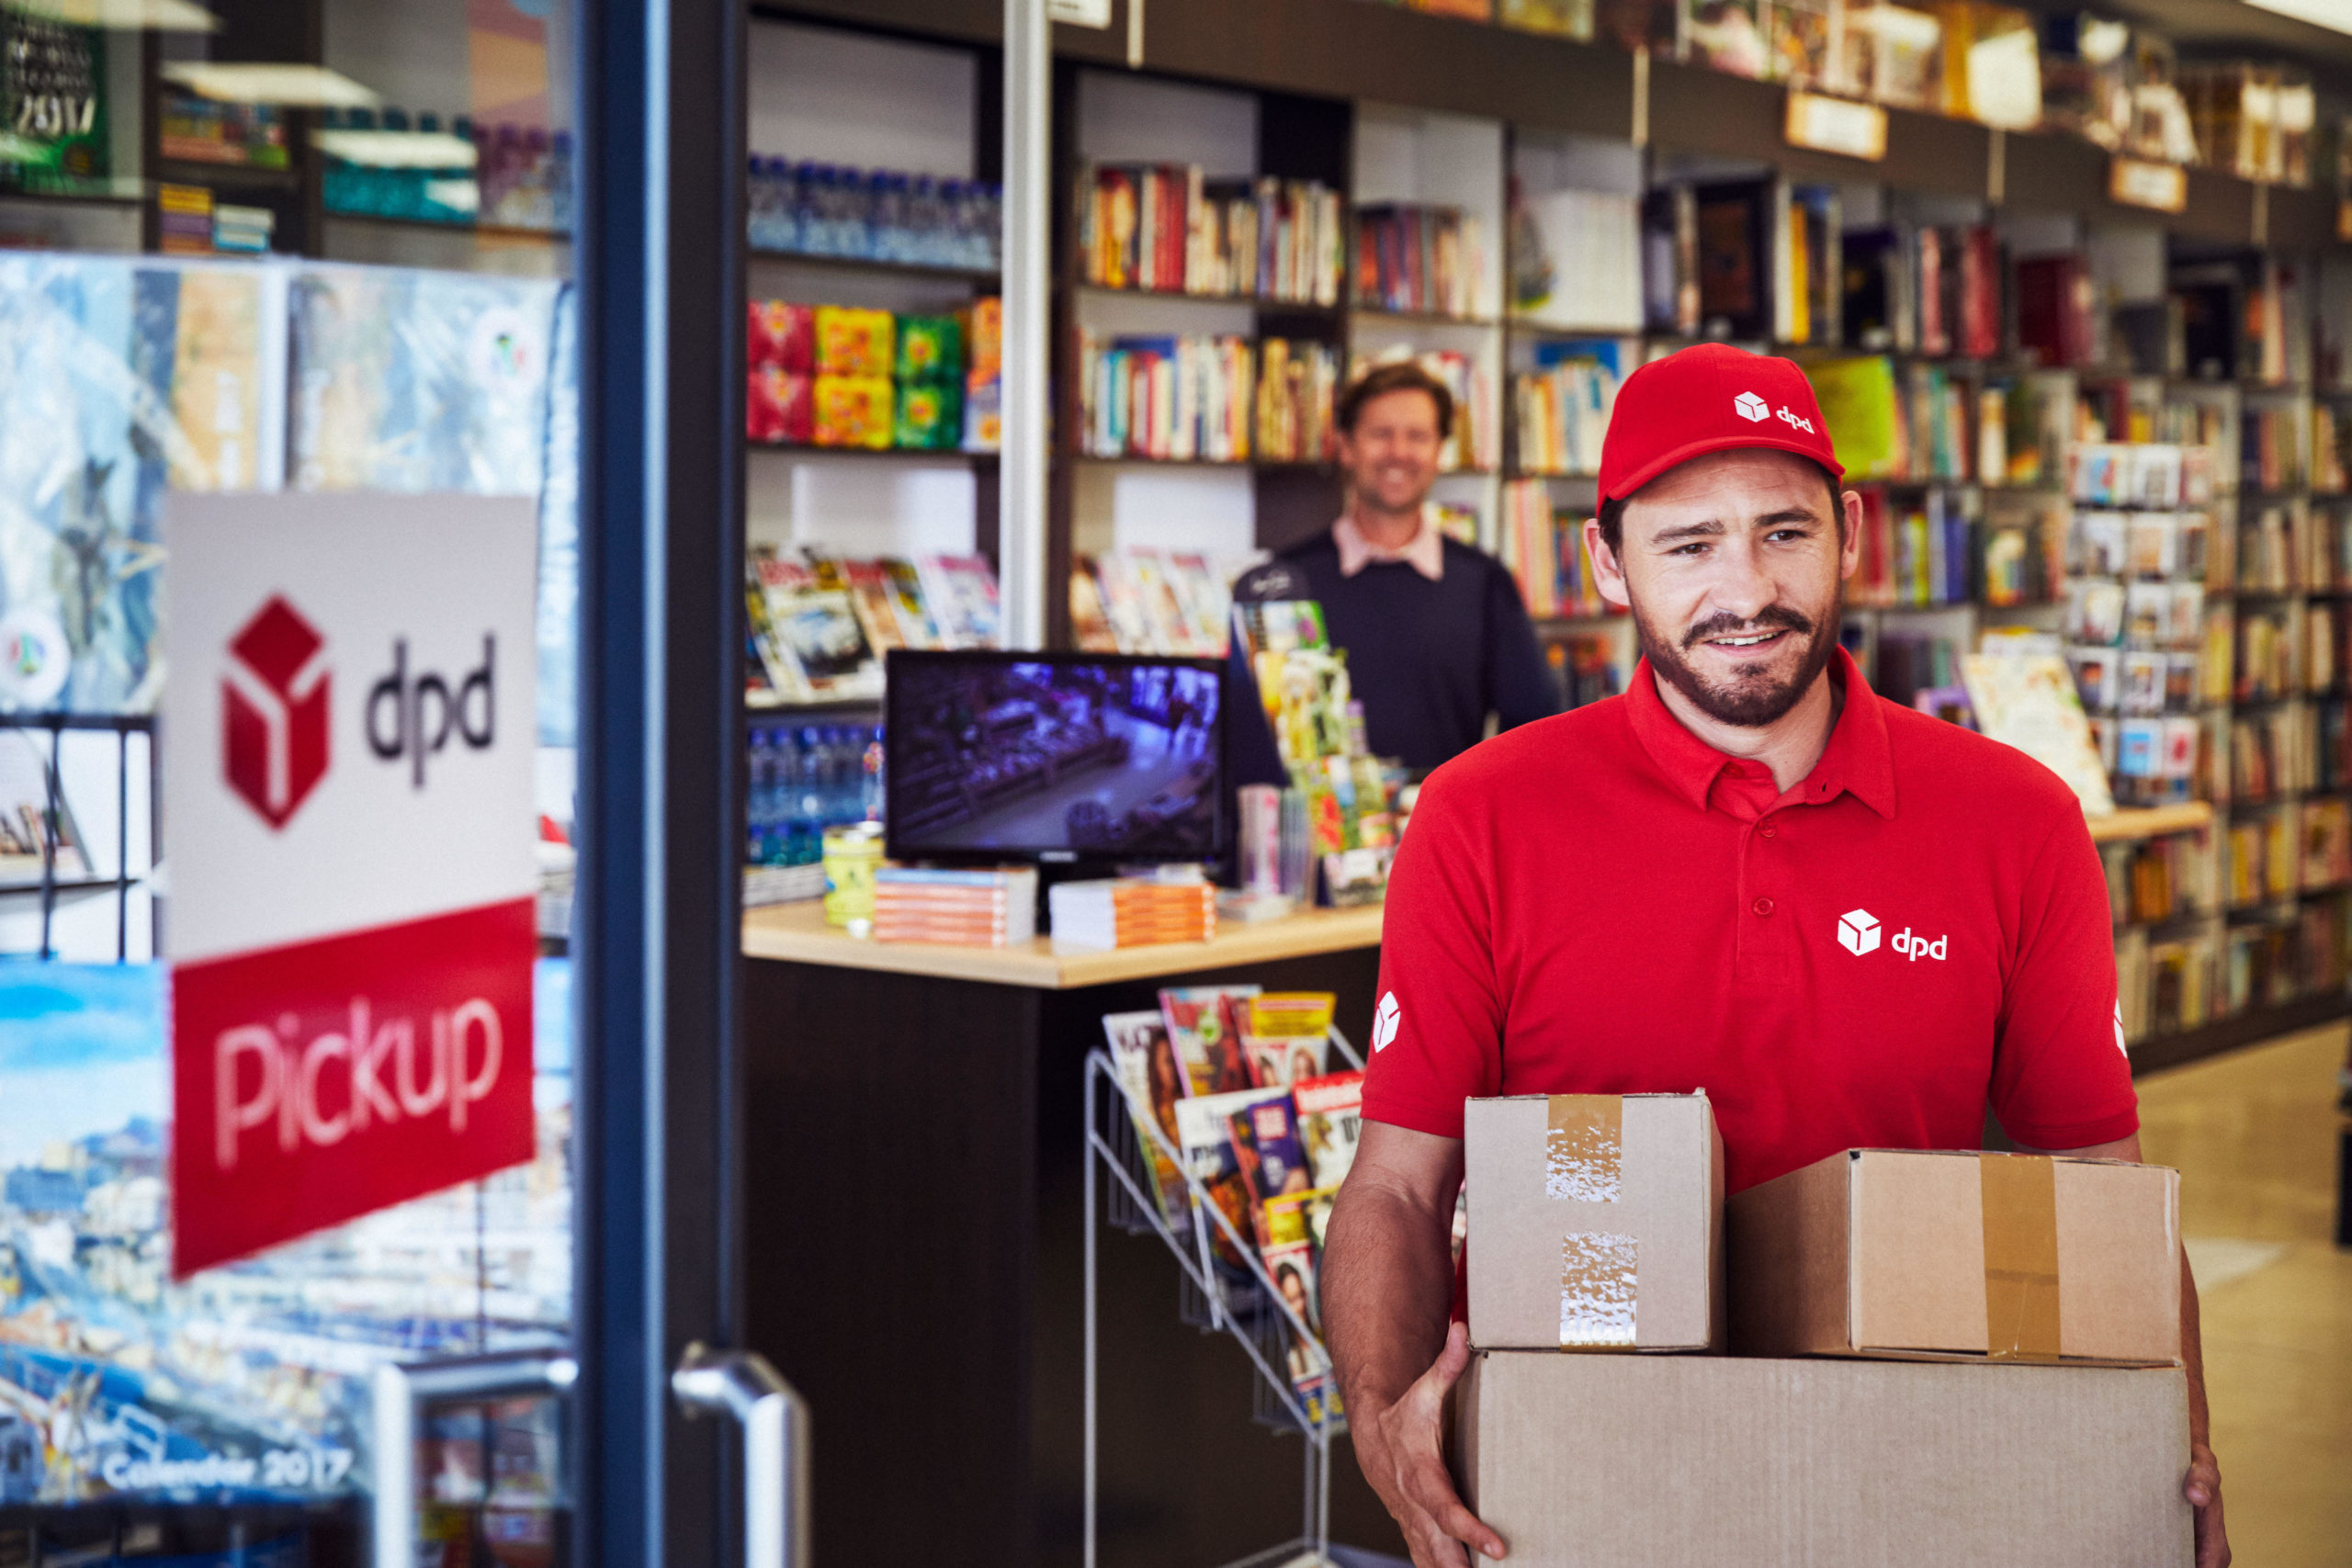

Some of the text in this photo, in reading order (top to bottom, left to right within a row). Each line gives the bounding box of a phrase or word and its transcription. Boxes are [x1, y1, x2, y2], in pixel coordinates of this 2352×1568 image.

[1776, 405, 1815, 435] dpd
[364, 631, 496, 789] dpd
[1891, 926, 1948, 962] dpd
[214, 995, 503, 1171] Pickup
[261, 1449, 353, 1493] 2017
